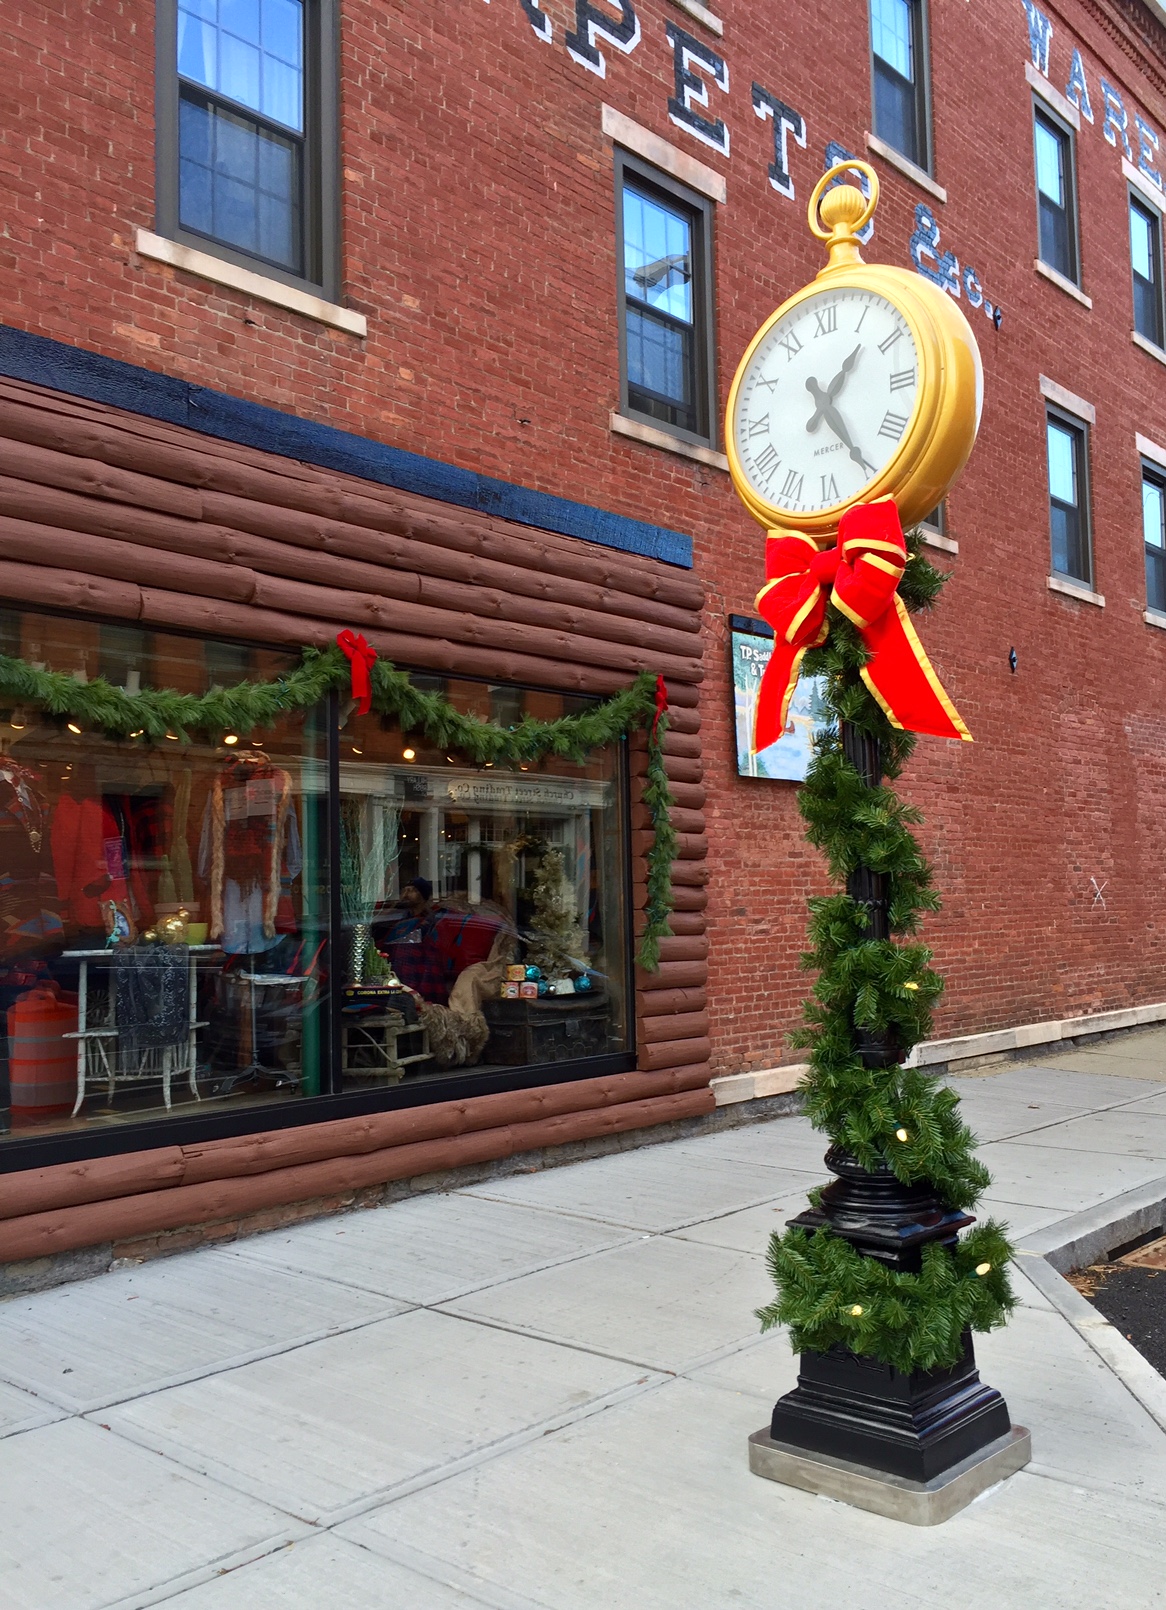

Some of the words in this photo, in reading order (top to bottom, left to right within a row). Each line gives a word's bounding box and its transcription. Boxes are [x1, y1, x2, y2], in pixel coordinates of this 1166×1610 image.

[813, 304, 838, 338] XII
[778, 328, 804, 363] XI
[877, 326, 904, 355] II
[755, 372, 779, 394] X
[889, 366, 916, 393] III
[748, 411, 770, 440] IX
[877, 409, 910, 442] IIII
[753, 442, 782, 484] VIII
[813, 442, 844, 457] MERCER
[779, 468, 805, 502] VII
[820, 473, 840, 502] VI
[751, 662, 758, 676] &
[754, 650, 772, 661] Saddl
